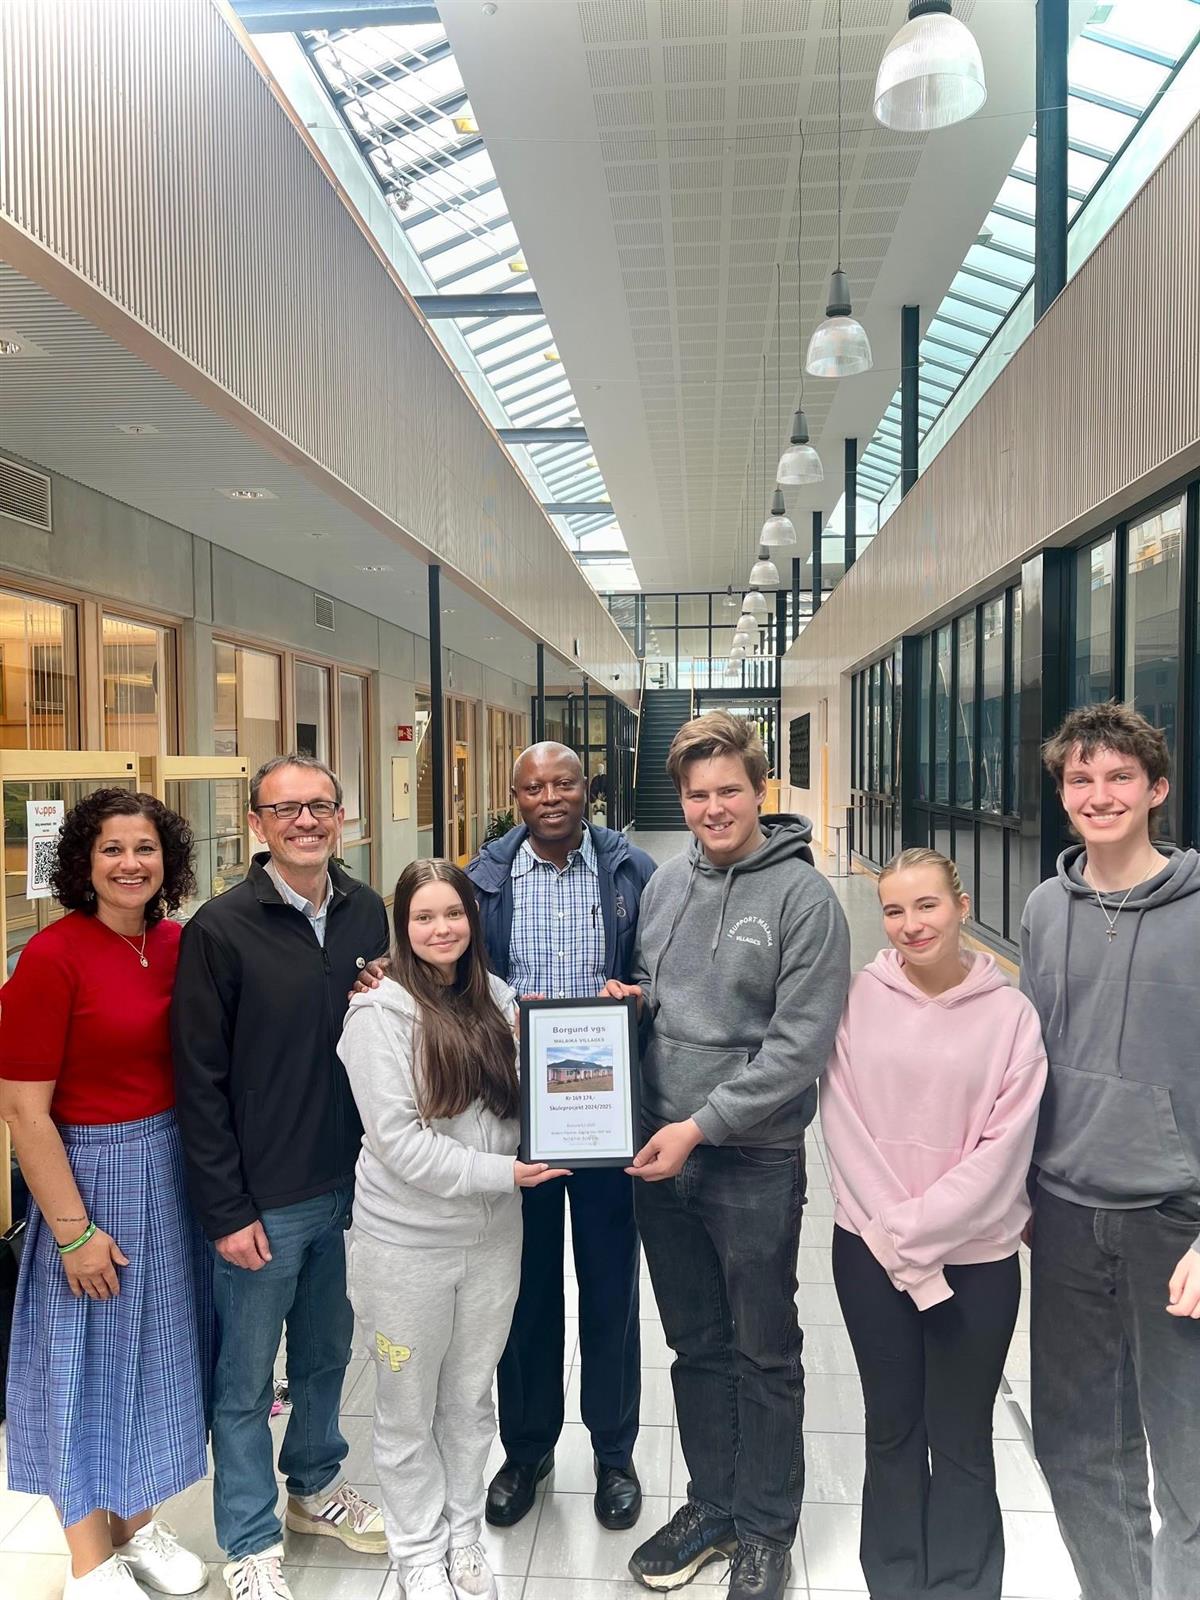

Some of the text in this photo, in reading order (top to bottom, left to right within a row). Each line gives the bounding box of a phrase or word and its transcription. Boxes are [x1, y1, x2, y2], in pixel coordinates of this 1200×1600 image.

[729, 916, 758, 935] SUPPORT
[552, 1026, 606, 1034] Borgund vgs
